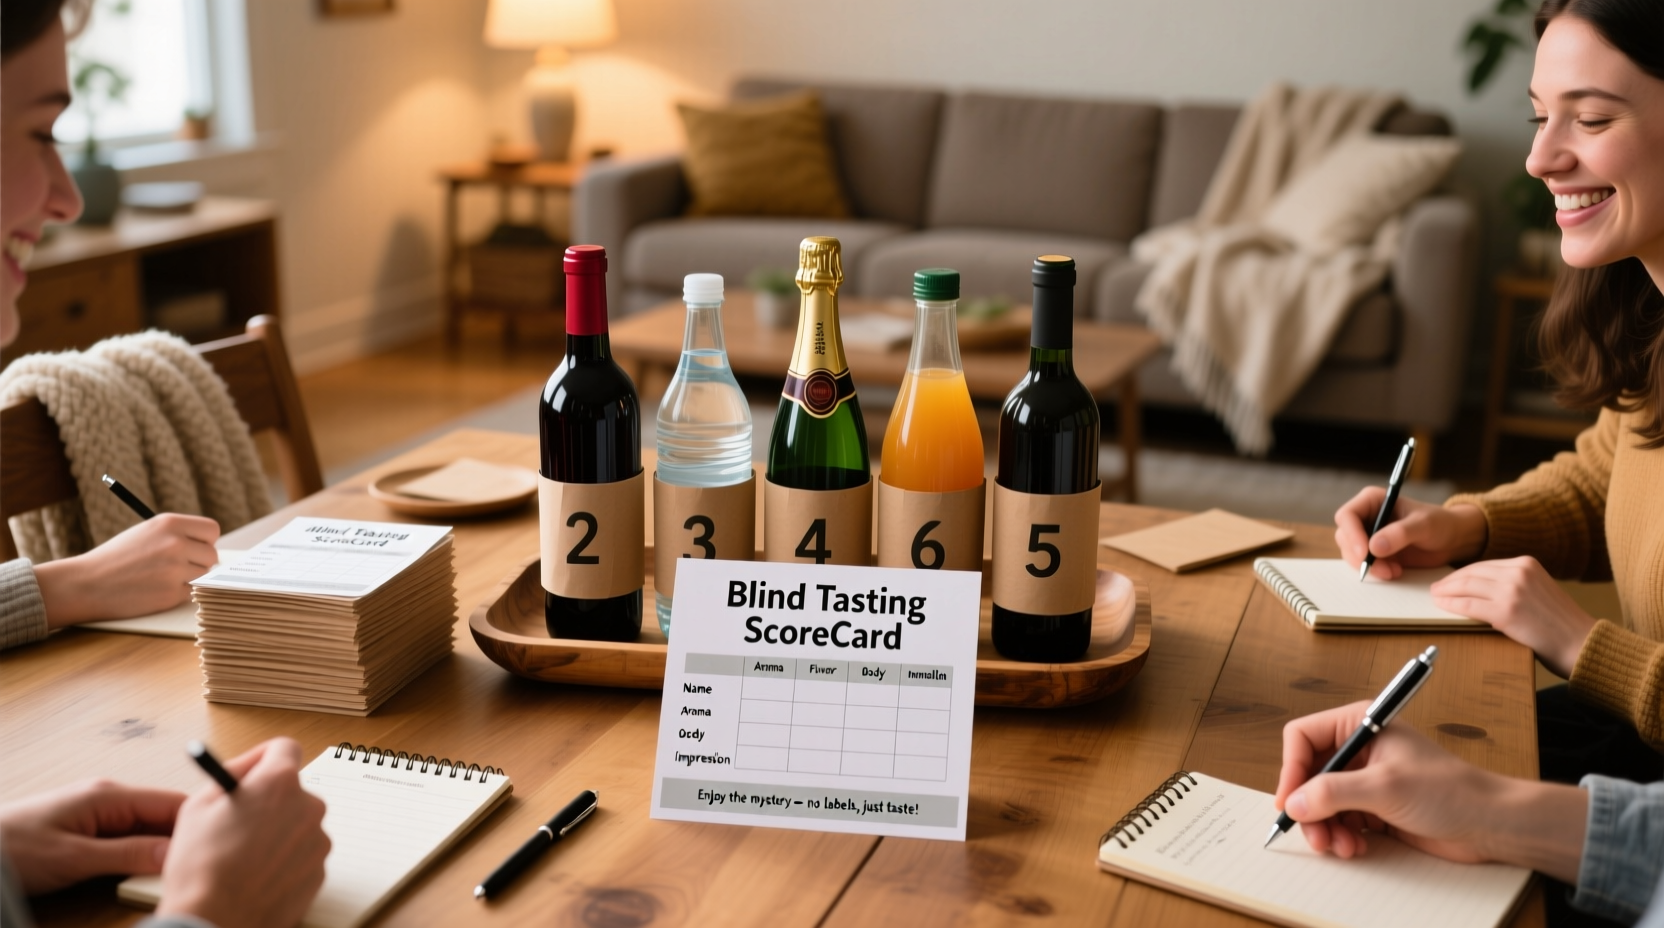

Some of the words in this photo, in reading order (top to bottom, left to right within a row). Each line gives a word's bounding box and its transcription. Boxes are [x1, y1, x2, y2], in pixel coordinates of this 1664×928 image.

[566, 511, 600, 565] 2
[683, 515, 717, 560] 3
[794, 518, 833, 565] 4
[910, 520, 947, 570] 6
[1025, 523, 1063, 578] 5
[727, 580, 807, 611] Blind
[816, 583, 927, 625] Tasting
[743, 615, 903, 650] ScoreCard
[683, 682, 713, 695] Name
[728, 790, 748, 804] the
[807, 798, 821, 809] no
[861, 799, 884, 816] just
